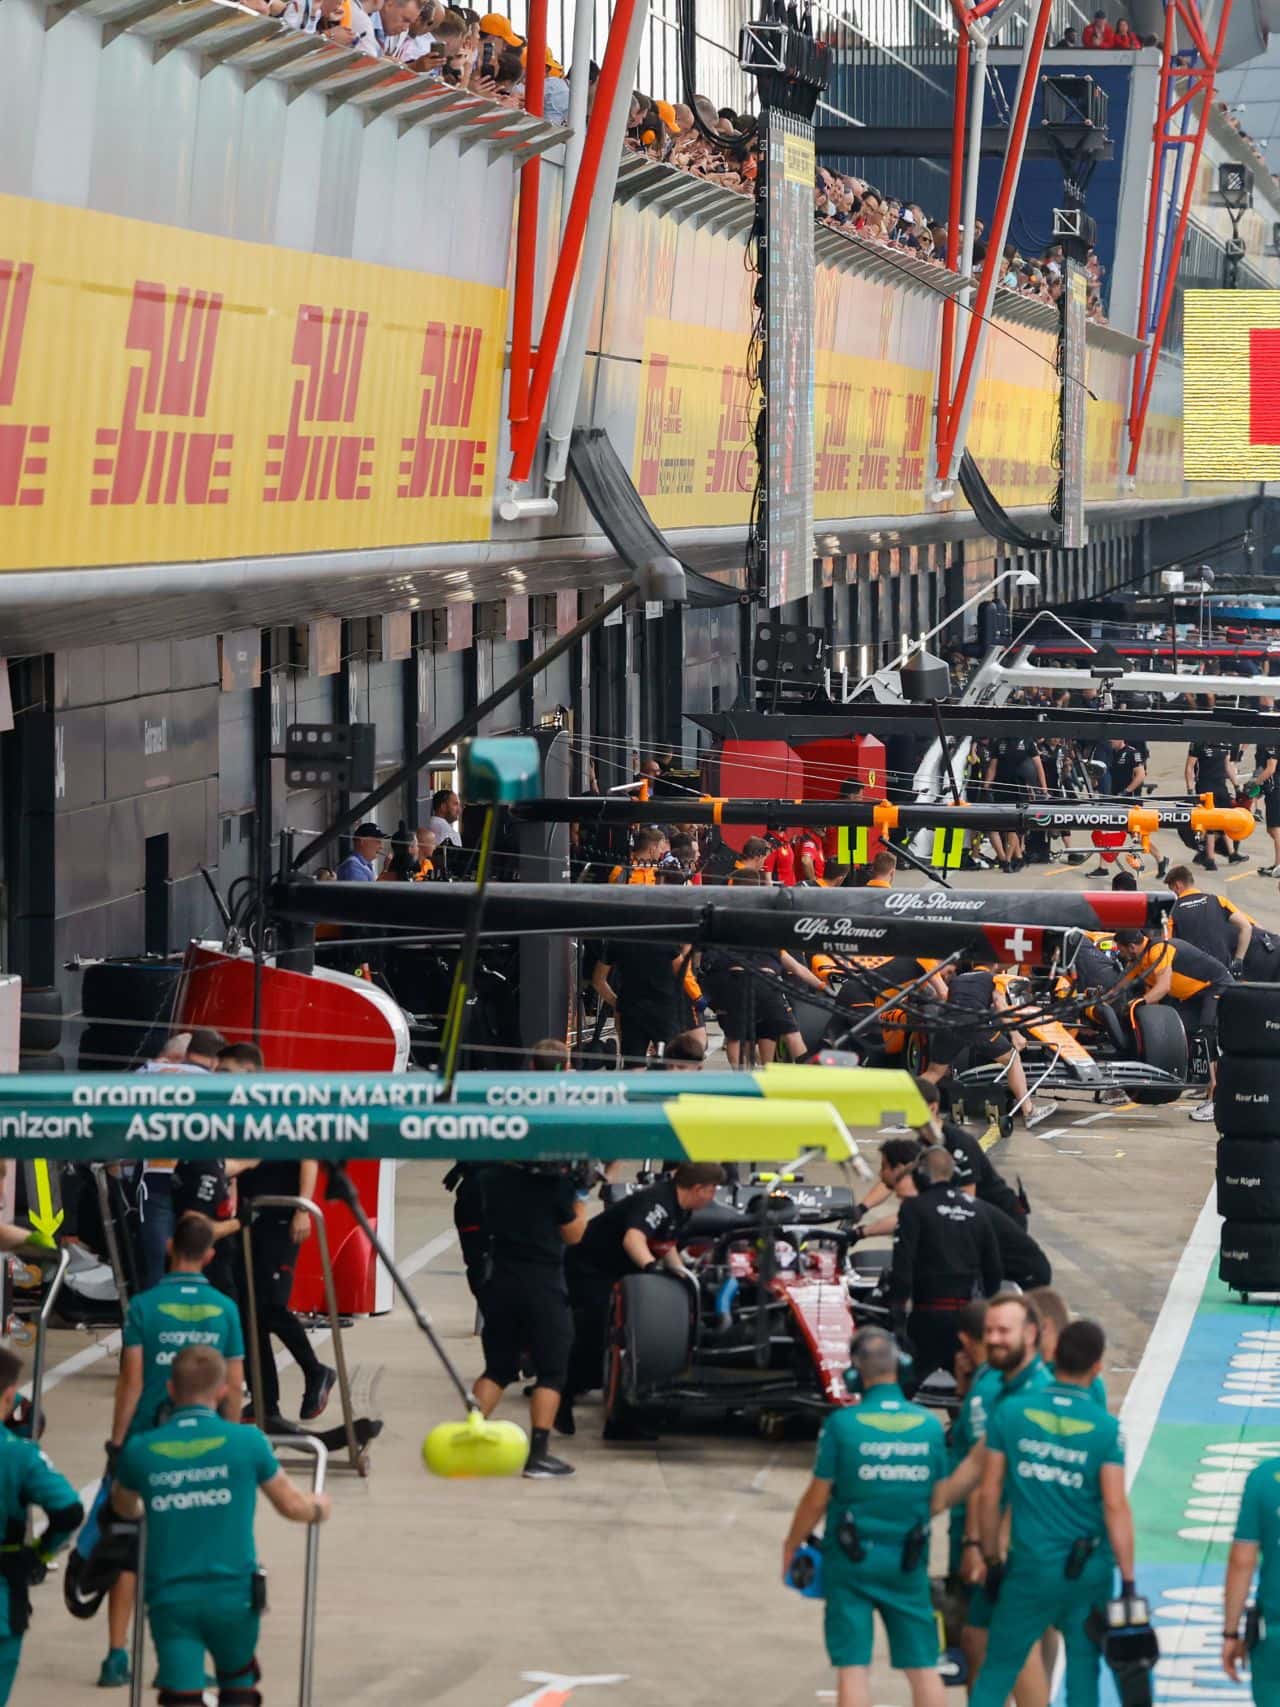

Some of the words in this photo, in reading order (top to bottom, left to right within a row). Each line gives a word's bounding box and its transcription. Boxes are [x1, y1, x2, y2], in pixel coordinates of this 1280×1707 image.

[1054, 813, 1074, 825] DP
[1076, 813, 1128, 825] WORLD
[1158, 812, 1191, 823] ORLD
[885, 892, 925, 915] Alfa
[926, 892, 986, 910] Romeo
[794, 917, 832, 941] Alfa
[831, 918, 887, 938] Romeo
[834, 942, 859, 952] TEAM
[72, 1083, 196, 1106] aramco
[229, 1082, 331, 1106] ASTON
[1253, 1094, 1270, 1104] Left
[0, 1110, 93, 1139] nizant
[125, 1111, 235, 1142] ASTON
[243, 1111, 370, 1142] MARTIN
[399, 1114, 529, 1141] aramco
[151, 1488, 232, 1512] aramco
